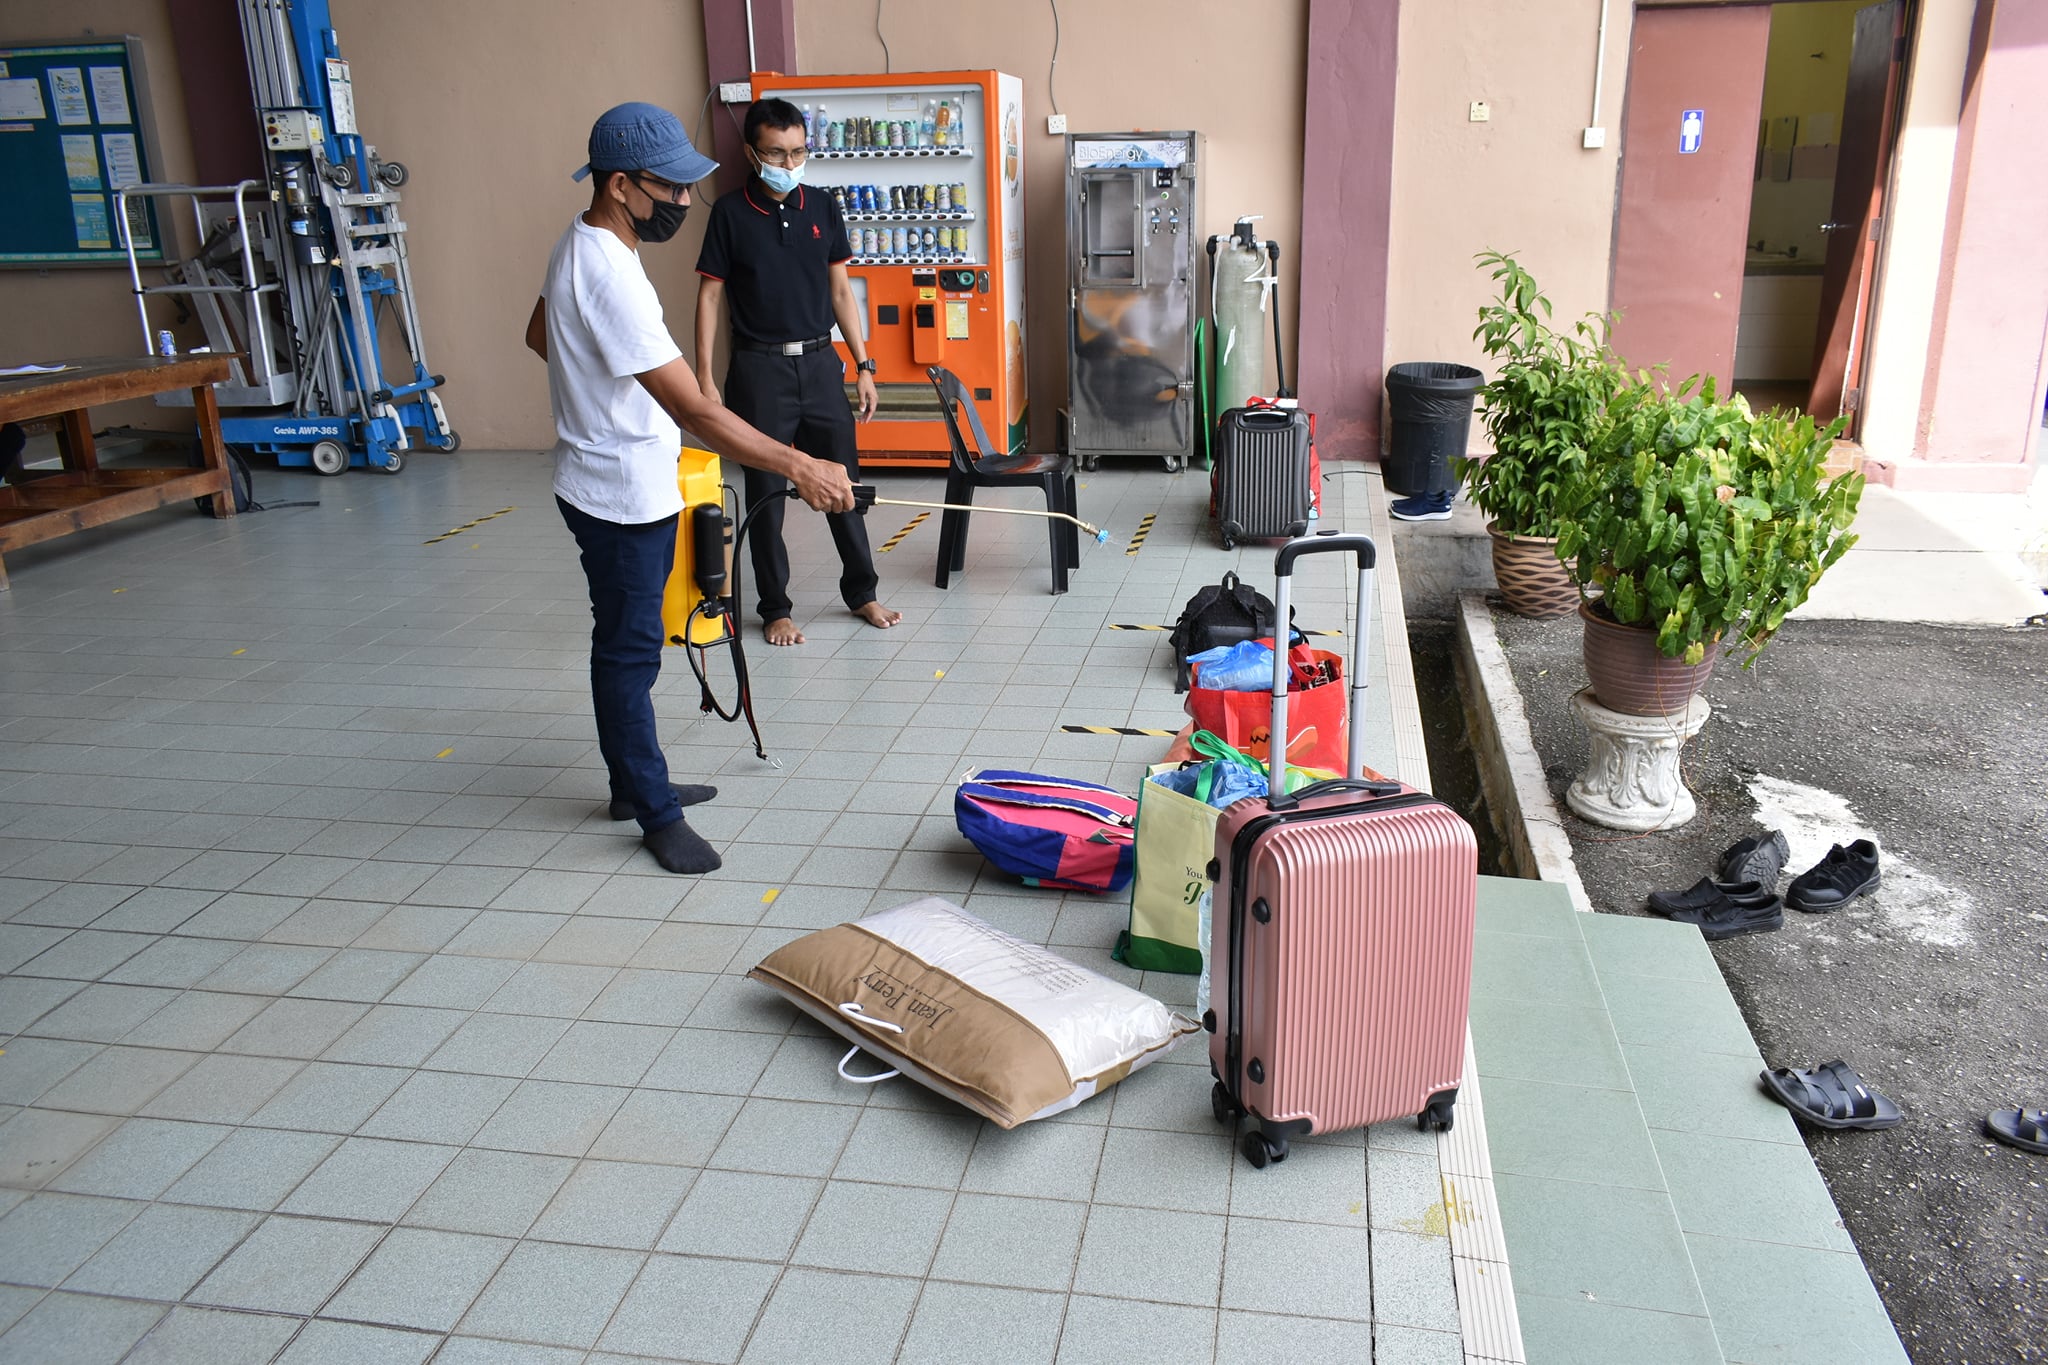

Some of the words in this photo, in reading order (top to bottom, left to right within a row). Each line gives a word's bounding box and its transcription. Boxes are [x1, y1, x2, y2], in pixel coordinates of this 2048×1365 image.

[273, 426, 297, 435] Genie
[298, 426, 339, 435] AWP-36S
[860, 970, 909, 1010] Perry
[906, 998, 954, 1030] Jean
